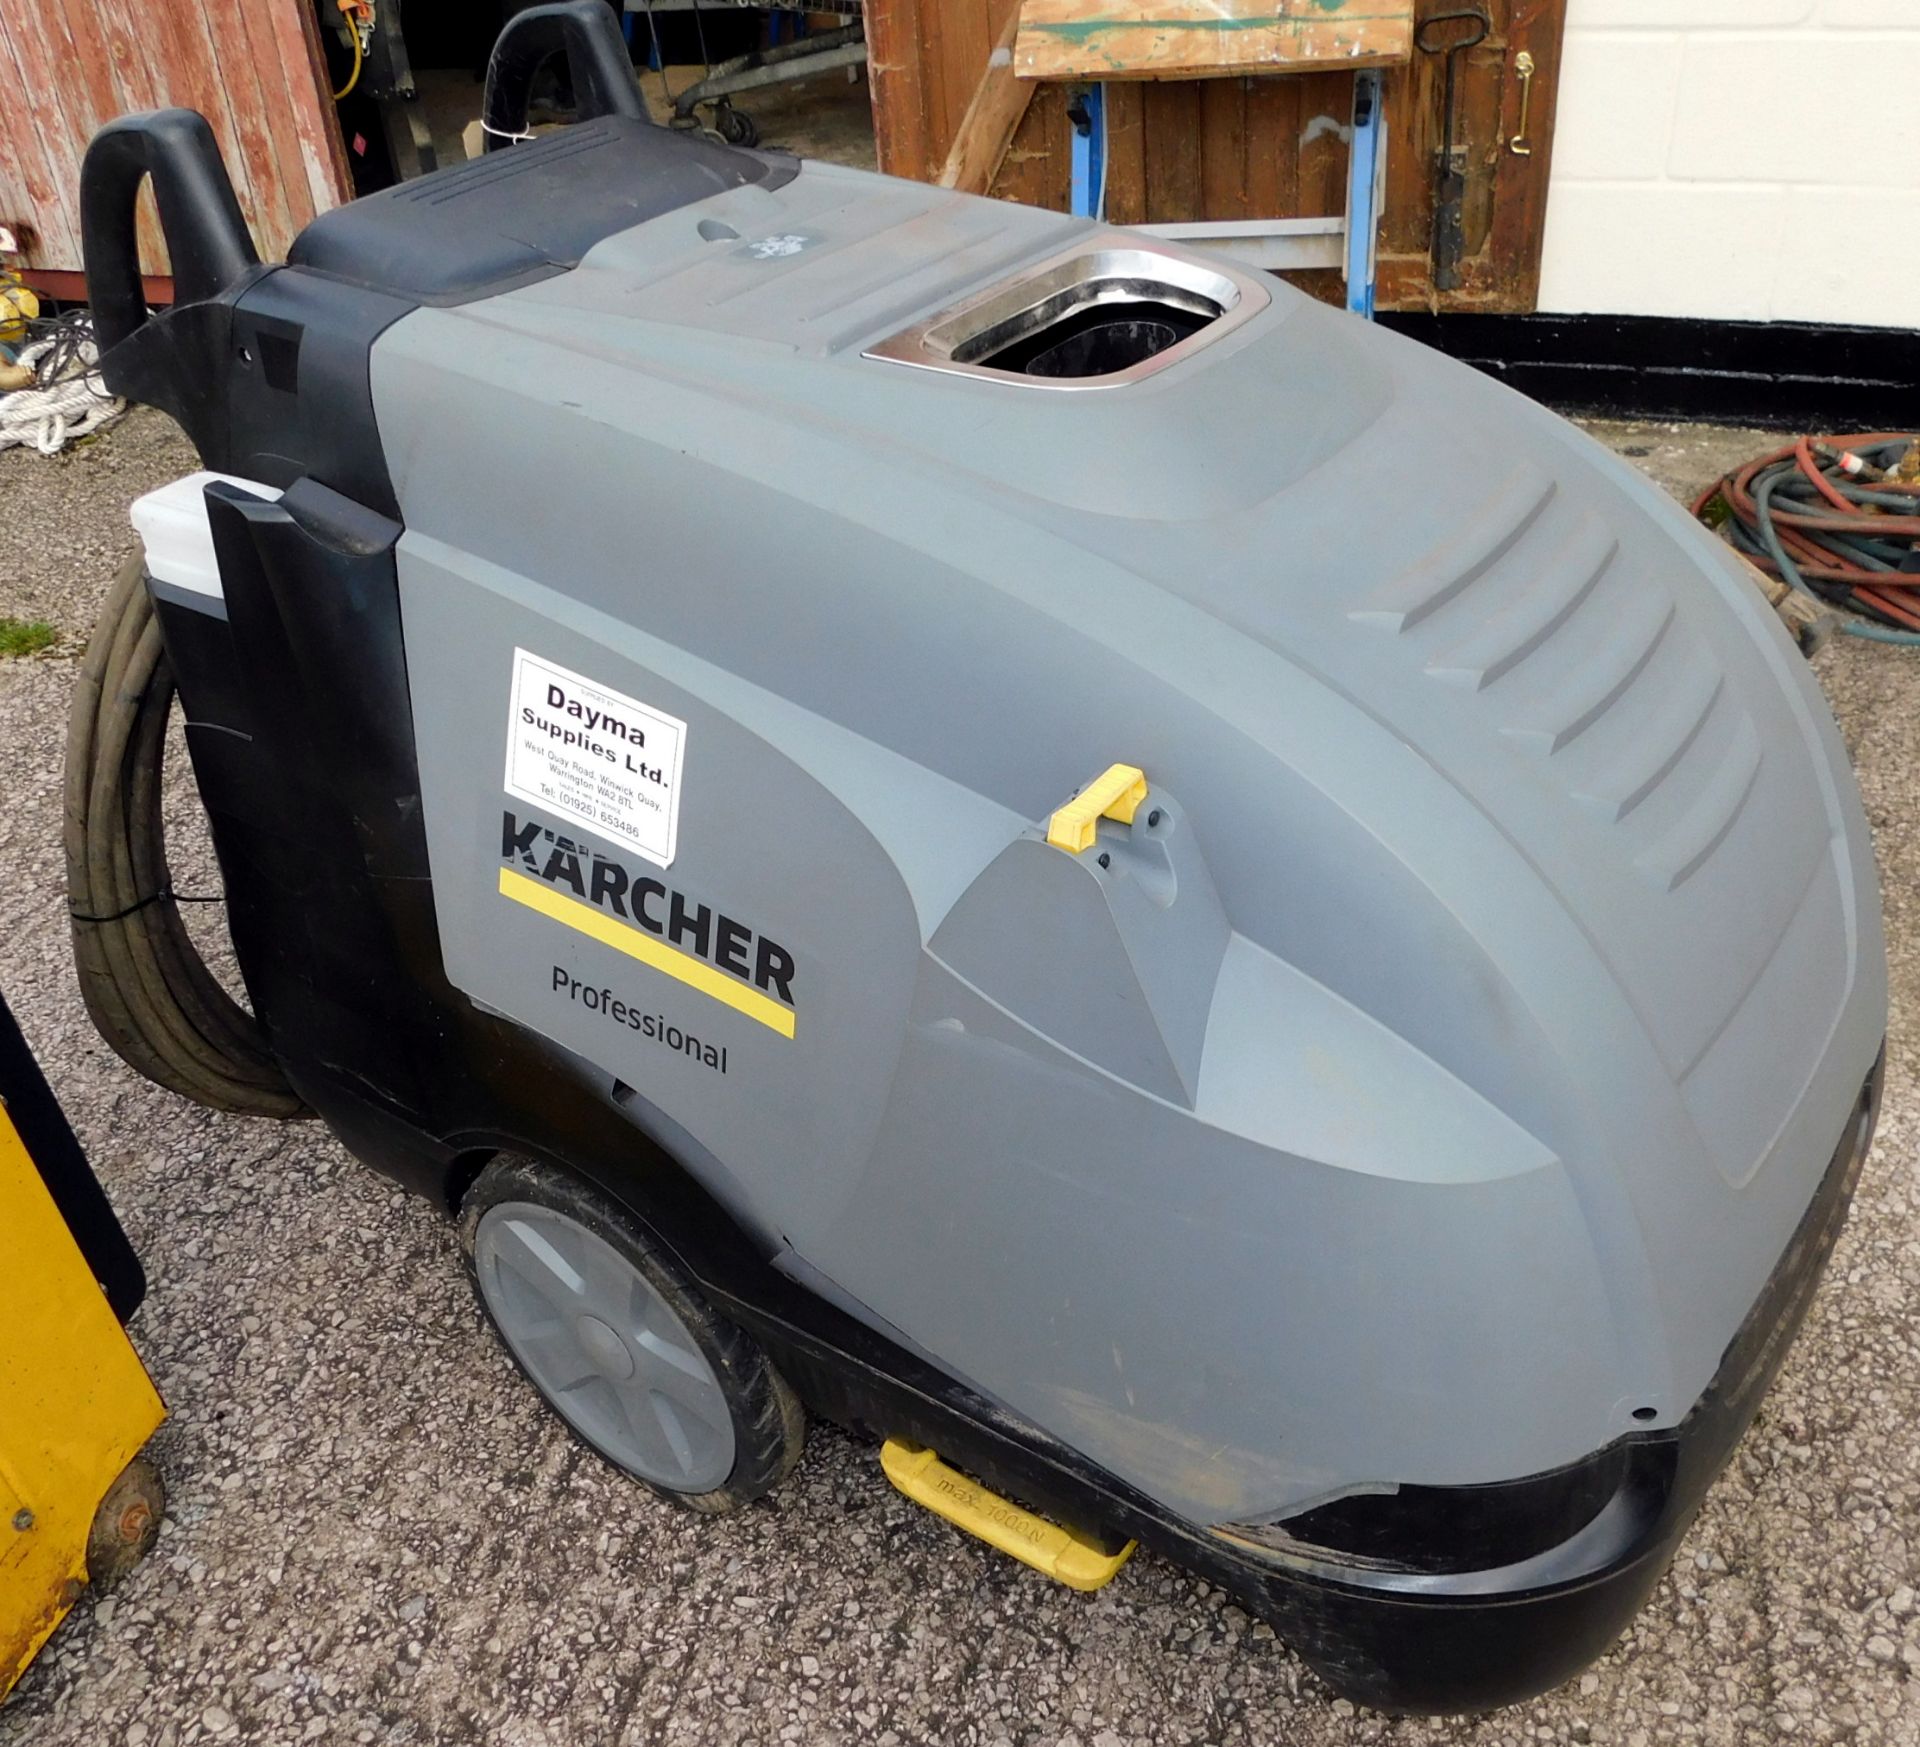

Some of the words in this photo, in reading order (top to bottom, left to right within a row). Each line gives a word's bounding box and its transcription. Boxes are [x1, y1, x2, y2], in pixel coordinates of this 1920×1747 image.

[521, 707, 617, 763] Supplies
[625, 754, 669, 789] Ltd.
[547, 683, 646, 749] Dayma
[525, 739, 545, 756] West
[547, 750, 569, 768] Quay
[599, 773, 634, 798] Winwick
[549, 762, 595, 790] Warrington
[597, 784, 616, 802] WA2
[540, 782, 557, 798] Tel:
[559, 791, 597, 818] (01925)
[600, 811, 640, 838] 653486
[502, 811, 796, 1006] KÄRCHER
[552, 965, 728, 1074] Professional
